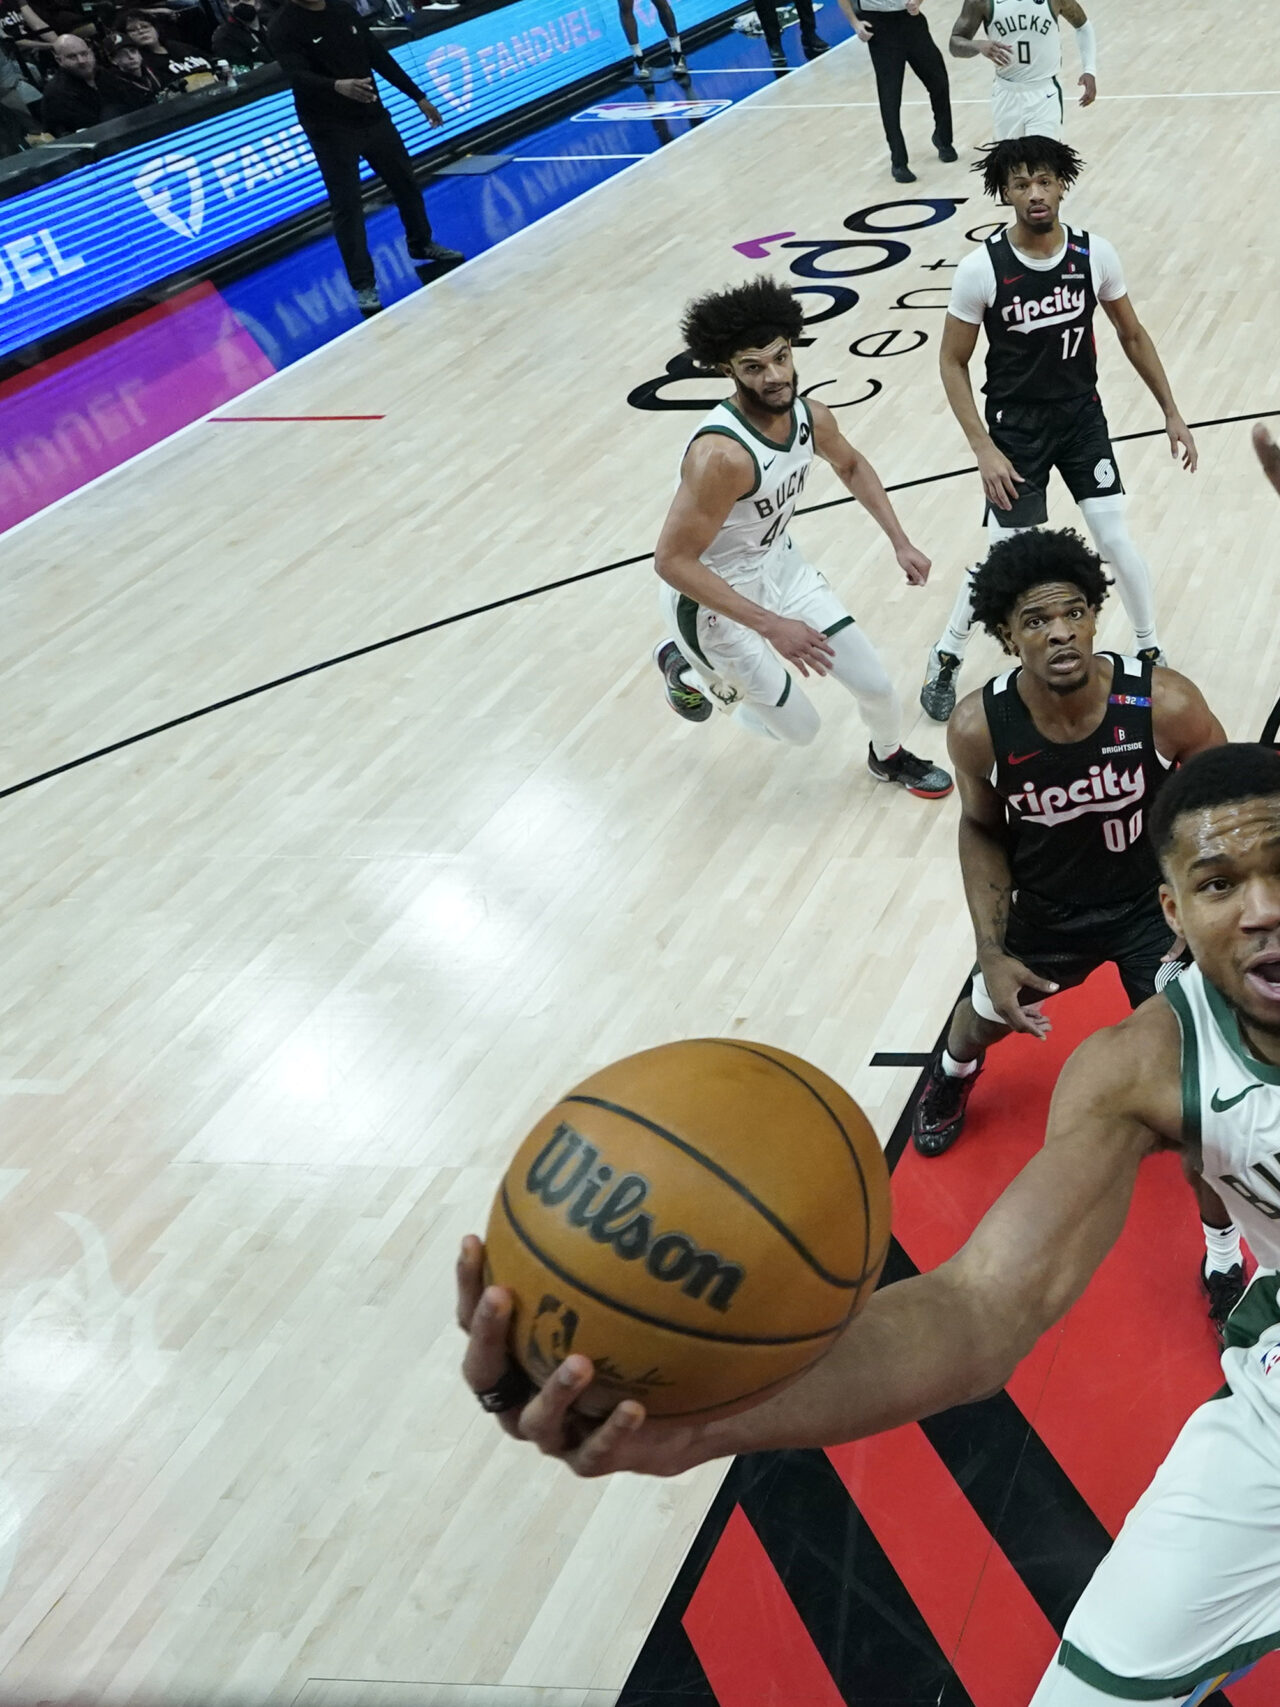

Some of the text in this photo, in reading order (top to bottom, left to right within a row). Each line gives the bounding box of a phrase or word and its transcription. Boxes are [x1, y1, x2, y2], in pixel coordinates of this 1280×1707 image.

[476, 8, 601, 86] FANDUEL
[994, 14, 1052, 37] BUCKS
[1017, 41, 1031, 64] 0
[1001, 284, 1085, 334] ripcity
[1061, 326, 1085, 360] 17
[1101, 741, 1144, 755] BRIGHTSIDE
[1008, 761, 1146, 827] ripcity
[1103, 808, 1144, 853] 00
[525, 1121, 747, 1313] Wilson
